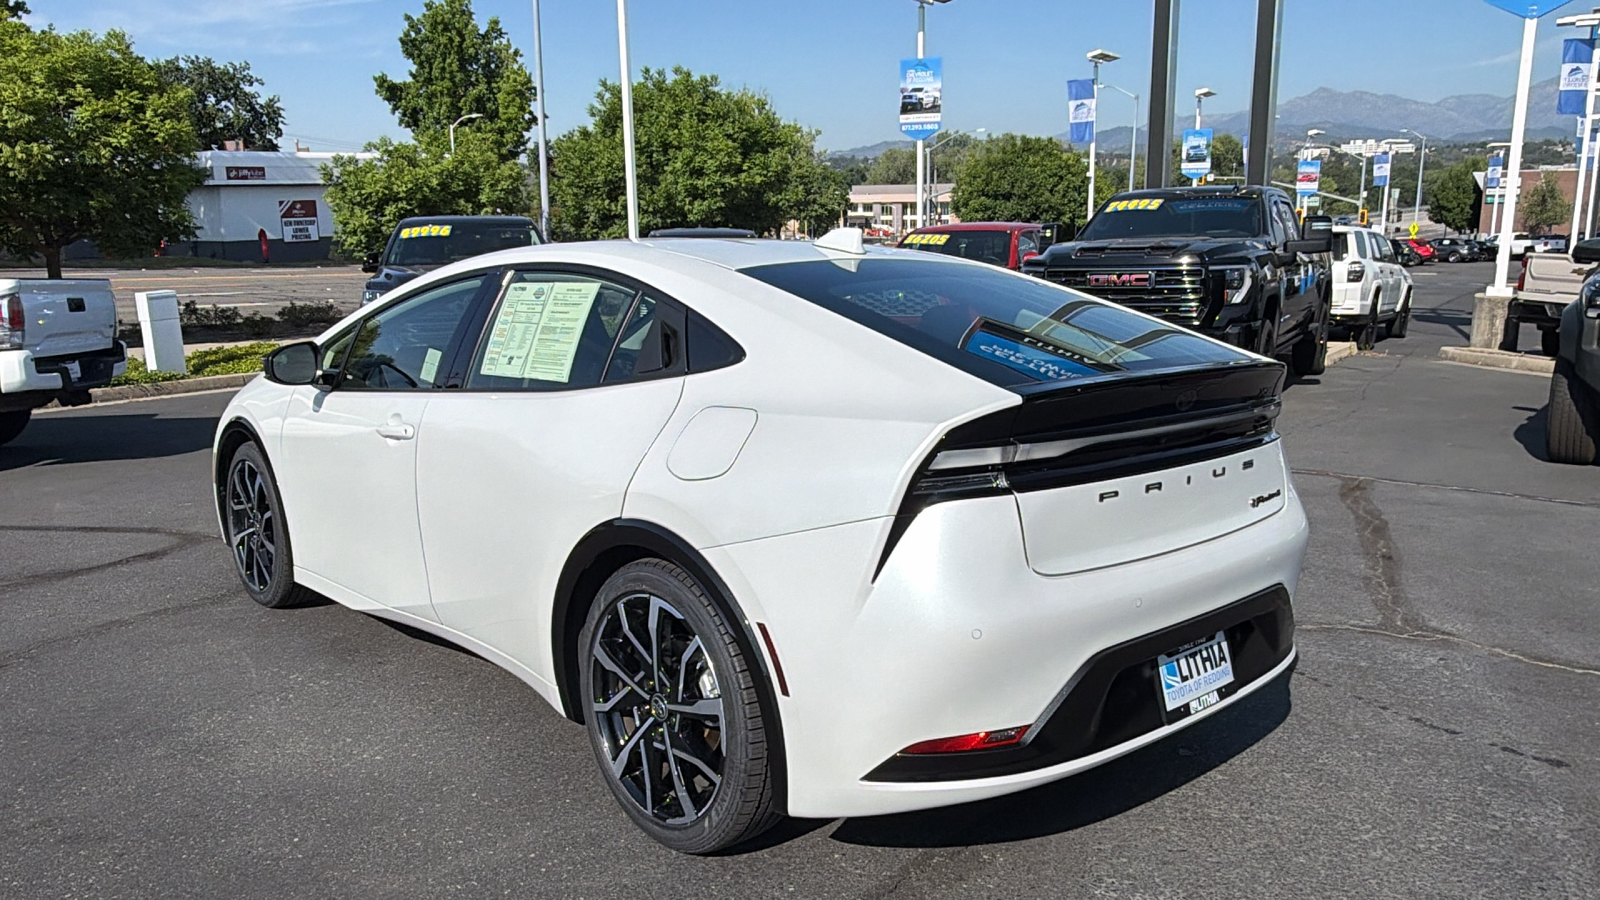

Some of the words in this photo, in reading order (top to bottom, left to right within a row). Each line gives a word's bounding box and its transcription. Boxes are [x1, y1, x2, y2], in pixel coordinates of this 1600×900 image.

[1089, 274, 1150, 287] GMC
[1098, 459, 1254, 502] PRIUS
[1175, 641, 1228, 684] LITHIA
[1166, 683, 1193, 702] TOYOTA
[1193, 679, 1203, 691] OF
[1203, 665, 1231, 687] REDDING
